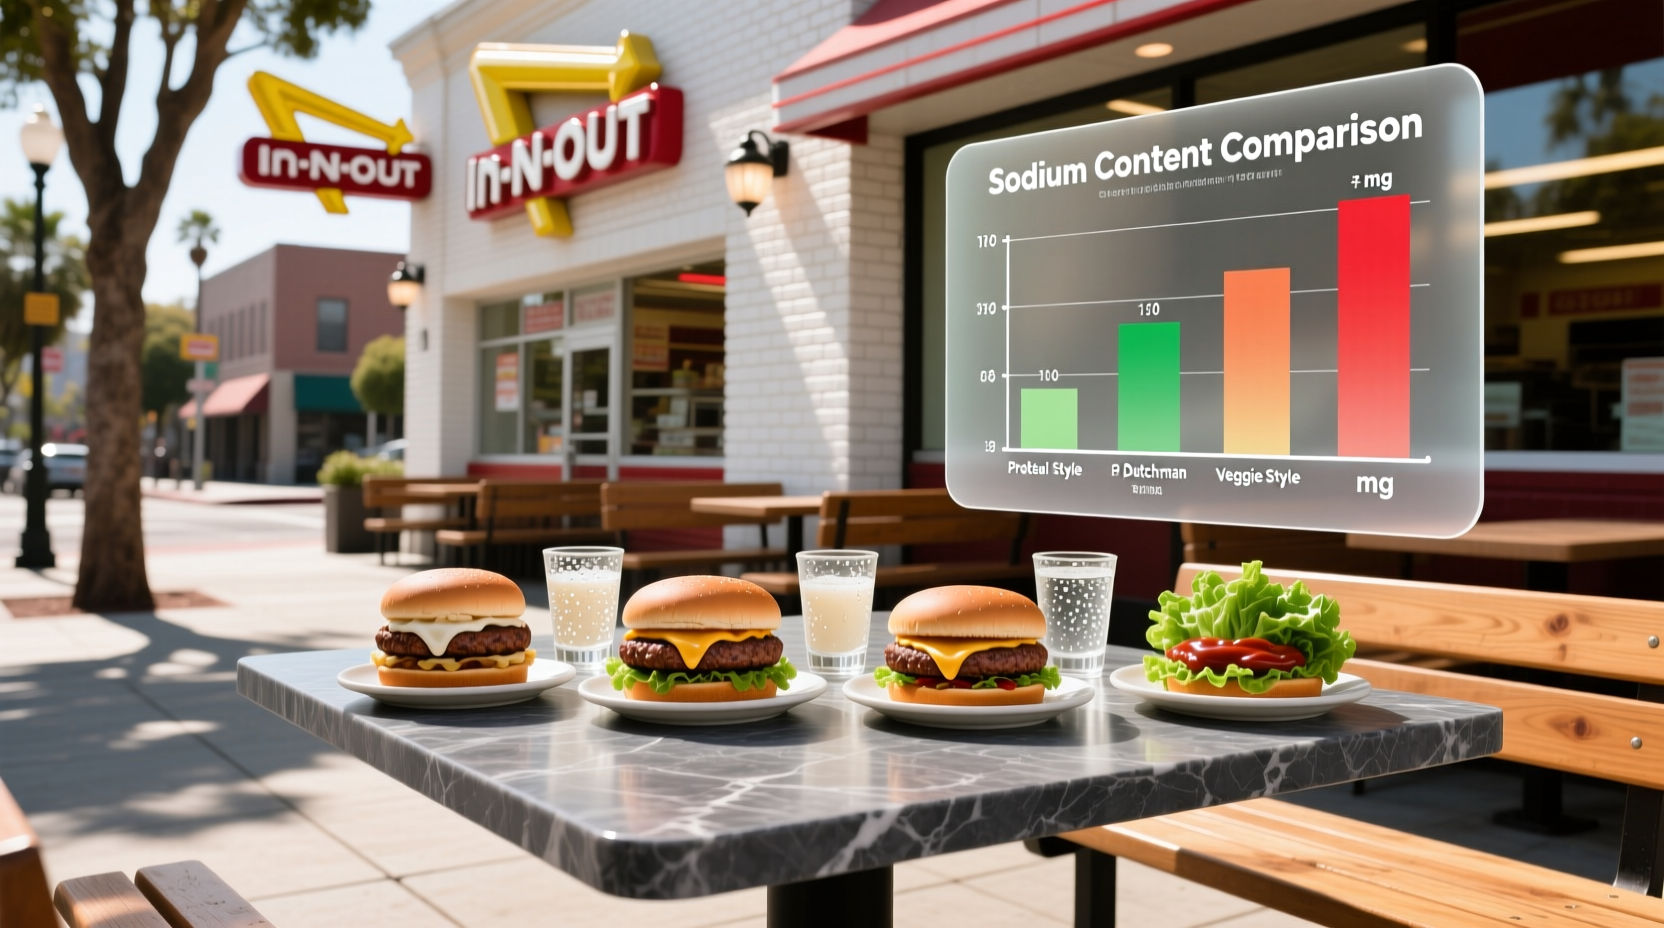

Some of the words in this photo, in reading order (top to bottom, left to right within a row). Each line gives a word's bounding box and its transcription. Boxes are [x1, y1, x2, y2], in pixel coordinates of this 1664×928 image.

[988, 161, 1087, 196] Sodium
[1093, 138, 1213, 180] Content
[1219, 112, 1423, 162] Comparison
[1364, 172, 1393, 191] mg
[1052, 461, 1083, 480] Style
[1123, 462, 1187, 480] Dutchman
[1215, 467, 1264, 487] Veggie
[1265, 468, 1301, 489] Style
[1356, 474, 1394, 499] mg
